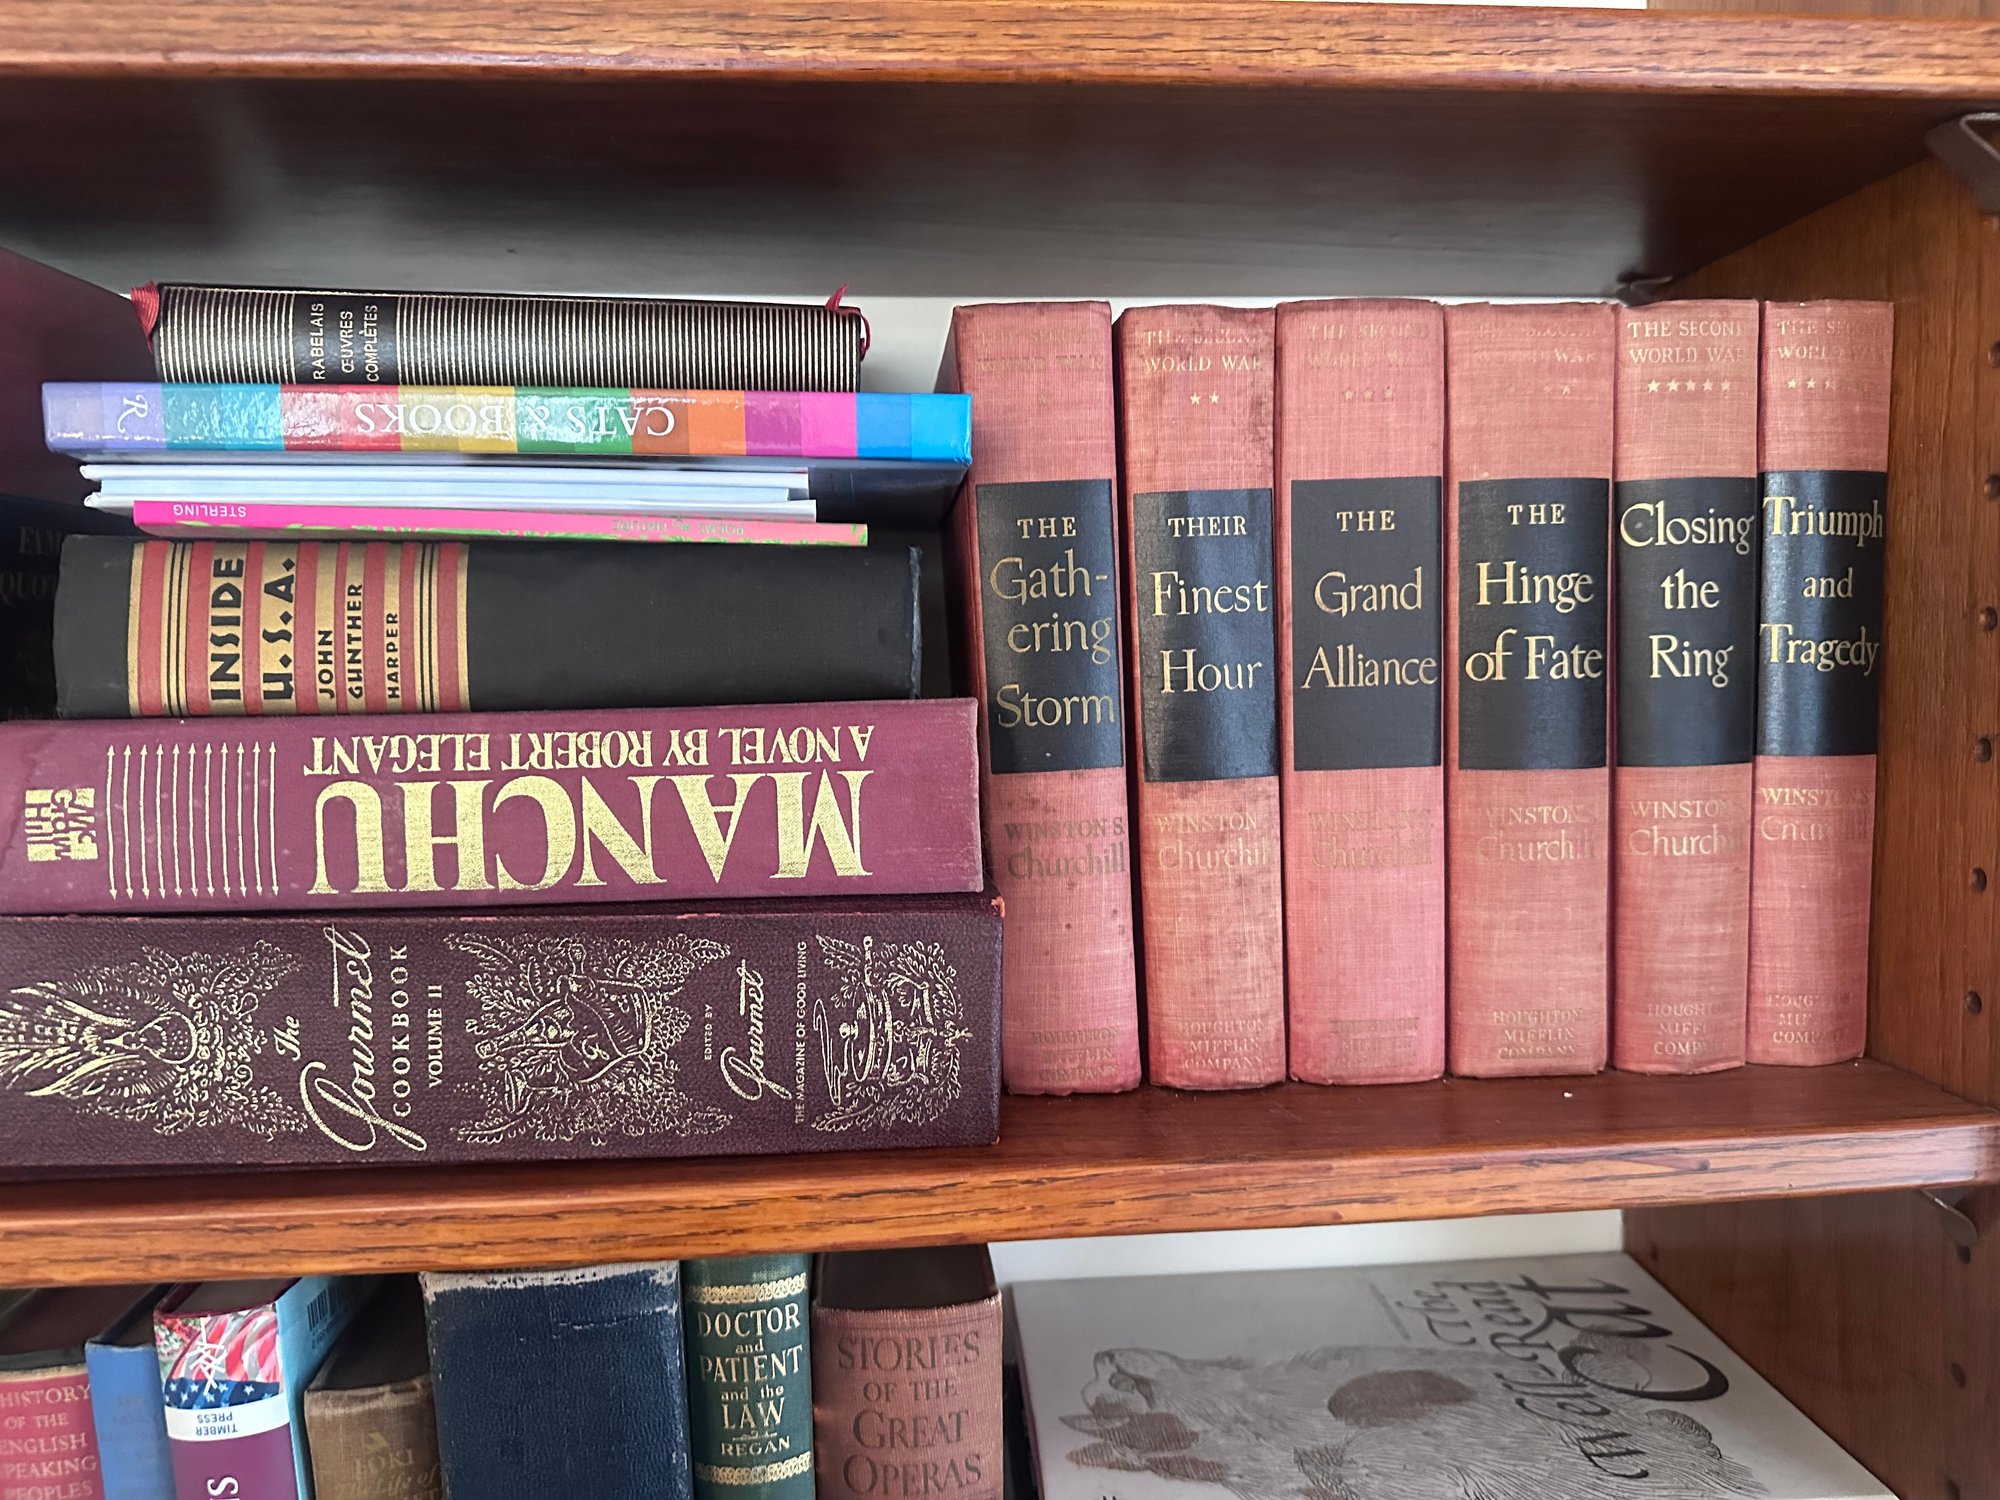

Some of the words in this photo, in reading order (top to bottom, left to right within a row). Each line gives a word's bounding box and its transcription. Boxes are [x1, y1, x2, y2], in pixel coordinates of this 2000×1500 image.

[313, 302, 325, 381] RABELAIS
[361, 304, 379, 383] COMPLÈTES
[1627, 320, 1672, 338] THE
[1627, 346, 1697, 365] WORLD
[356, 402, 505, 436] BOOKS
[566, 403, 676, 437] CATS
[172, 503, 248, 519] STERLING
[1016, 516, 1077, 539] THE
[1167, 515, 1248, 538] THEIR
[1336, 510, 1396, 532] THE
[1507, 503, 1566, 526] THE
[1619, 500, 1756, 556] Closing
[1761, 495, 1884, 548] Triumph
[989, 548, 1109, 606] Gath-
[1149, 571, 1269, 617] Finest
[1313, 566, 1423, 618] Grand
[1475, 560, 1595, 614] Hinge
[1659, 567, 1721, 610] the
[1802, 566, 1854, 599] and
[210, 557, 244, 701] INSIDE
[262, 556, 295, 700] U.S.A.
[346, 583, 364, 699] GUNTHER
[1006, 612, 1113, 665] ering
[317, 628, 334, 700] JOHN
[385, 611, 400, 699] HARPER
[1299, 643, 1438, 689] Alliance
[1464, 628, 1518, 682] of
[1522, 634, 1603, 681] Fate
[1648, 634, 1735, 688] Ring
[1759, 622, 1880, 677] Tragedy
[1159, 648, 1263, 694] Hour
[995, 683, 1116, 728] Storm
[303, 733, 491, 776] ELEGANT
[500, 729, 653, 771] ROBERT
[664, 728, 709, 767] BY
[718, 726, 841, 766] NOVEL
[848, 724, 875, 763] A
[306, 768, 875, 895] MANCHU
[1003, 818, 1108, 842] WINSTON
[1155, 812, 1258, 833] WINSTON
[1628, 823, 1745, 857] Church
[1007, 842, 1127, 880] Churchill
[797, 941, 808, 979] LIVING
[427, 984, 443, 999] II
[704, 1003, 713, 1019] BY
[796, 981, 807, 1020] GOOD
[272, 1015, 302, 1061] The
[300, 922, 428, 1152] Gourmet
[427, 1007, 443, 1089] VOLUME
[704, 1022, 713, 1061] EDITED
[720, 958, 793, 1101] Gourmet
[795, 1021, 807, 1038] OF
[795, 1040, 806, 1101] MAGAZINE
[794, 1102, 805, 1125] THE
[698, 1302, 801, 1339] DOCTOR
[701, 1344, 803, 1384] PATIENT
[735, 1338, 765, 1354] and
[837, 1330, 981, 1373] STORIES
[0, 1384, 92, 1408] HISTORY
[721, 1386, 750, 1401] and
[759, 1385, 785, 1400] the
[863, 1381, 898, 1402] OF
[908, 1378, 958, 1401] THE
[5, 1415, 27, 1431] OF
[33, 1412, 70, 1429] THE
[195, 1423, 239, 1437] TIMBER
[197, 1411, 234, 1424] PRESS
[722, 1397, 785, 1431] LAW
[852, 1409, 969, 1450] GREAT
[720, 1435, 791, 1457] REGAN
[5, 1479, 94, 1500] PEOPLES
[843, 1454, 982, 1498] OPERAS
